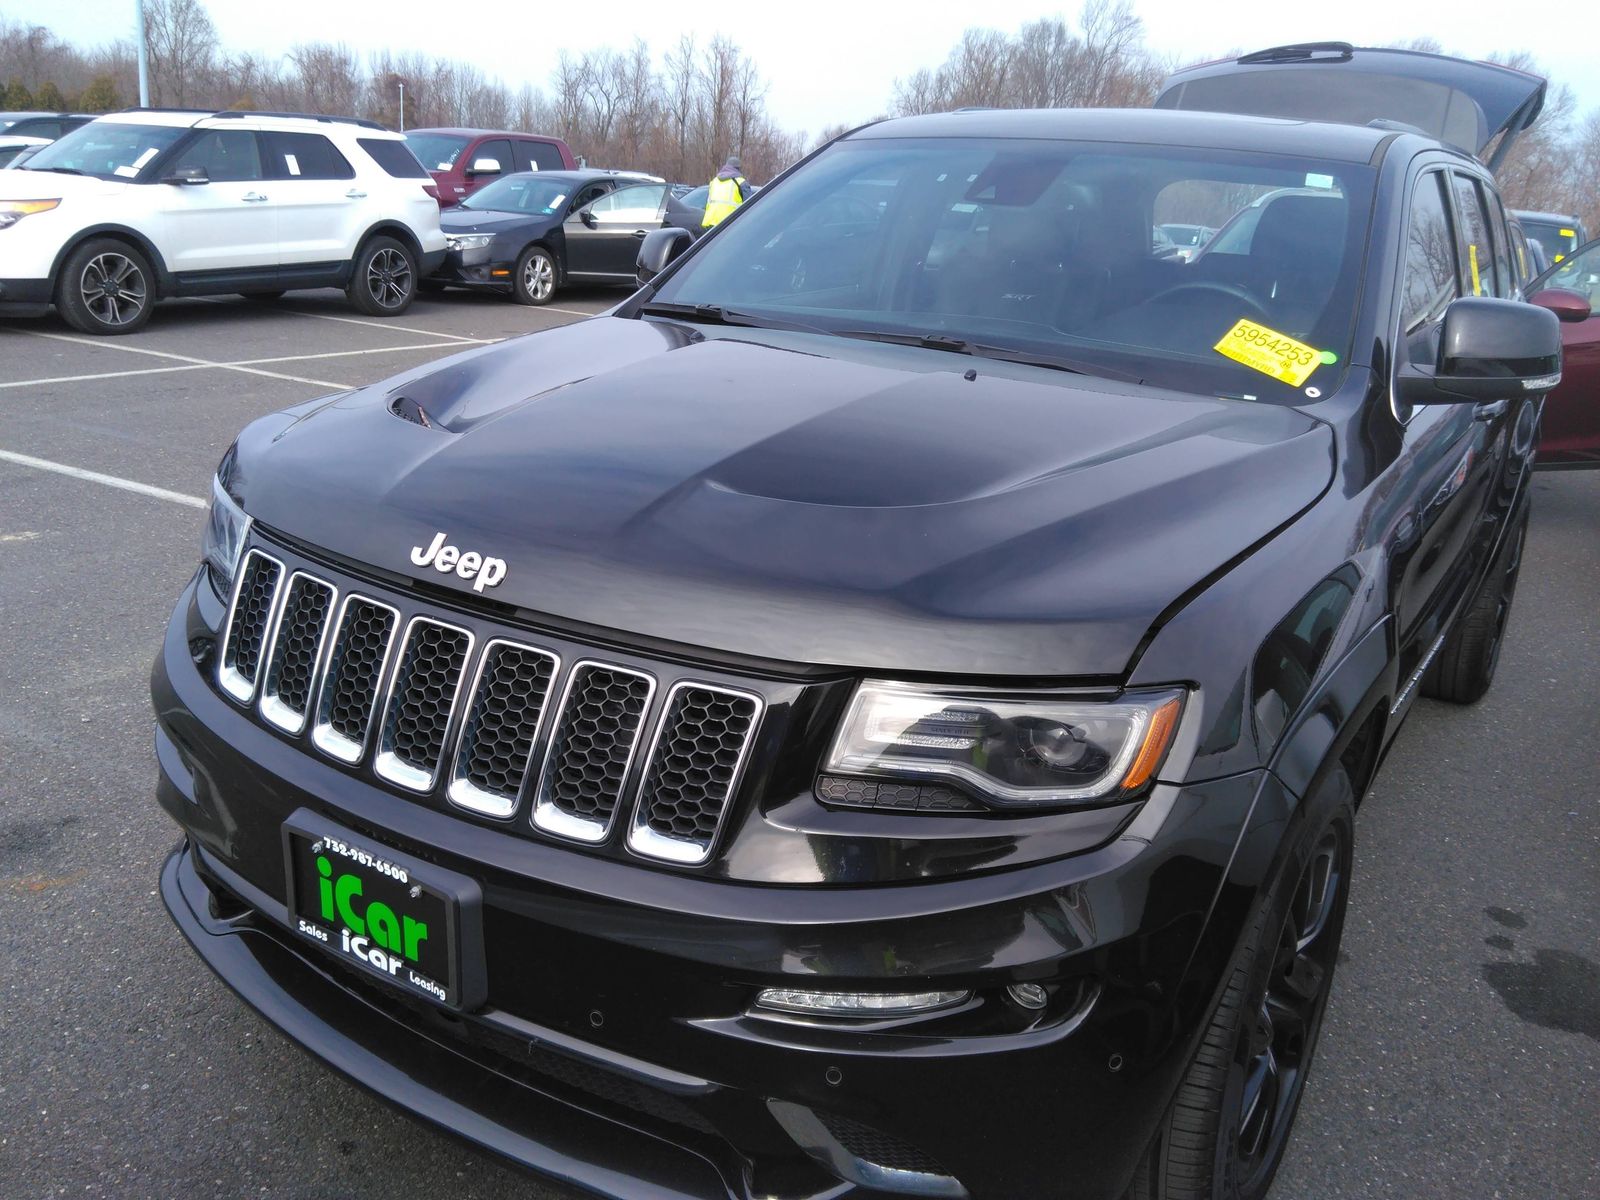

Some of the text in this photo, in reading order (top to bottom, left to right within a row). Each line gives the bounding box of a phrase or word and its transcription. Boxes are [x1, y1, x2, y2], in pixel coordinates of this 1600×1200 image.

[1233, 324, 1313, 365] 5954253
[410, 532, 508, 593] Jeep
[323, 836, 409, 884] 732-987-6500
[316, 856, 428, 961] iCar
[298, 920, 446, 1001] Sales iCar Leasing
